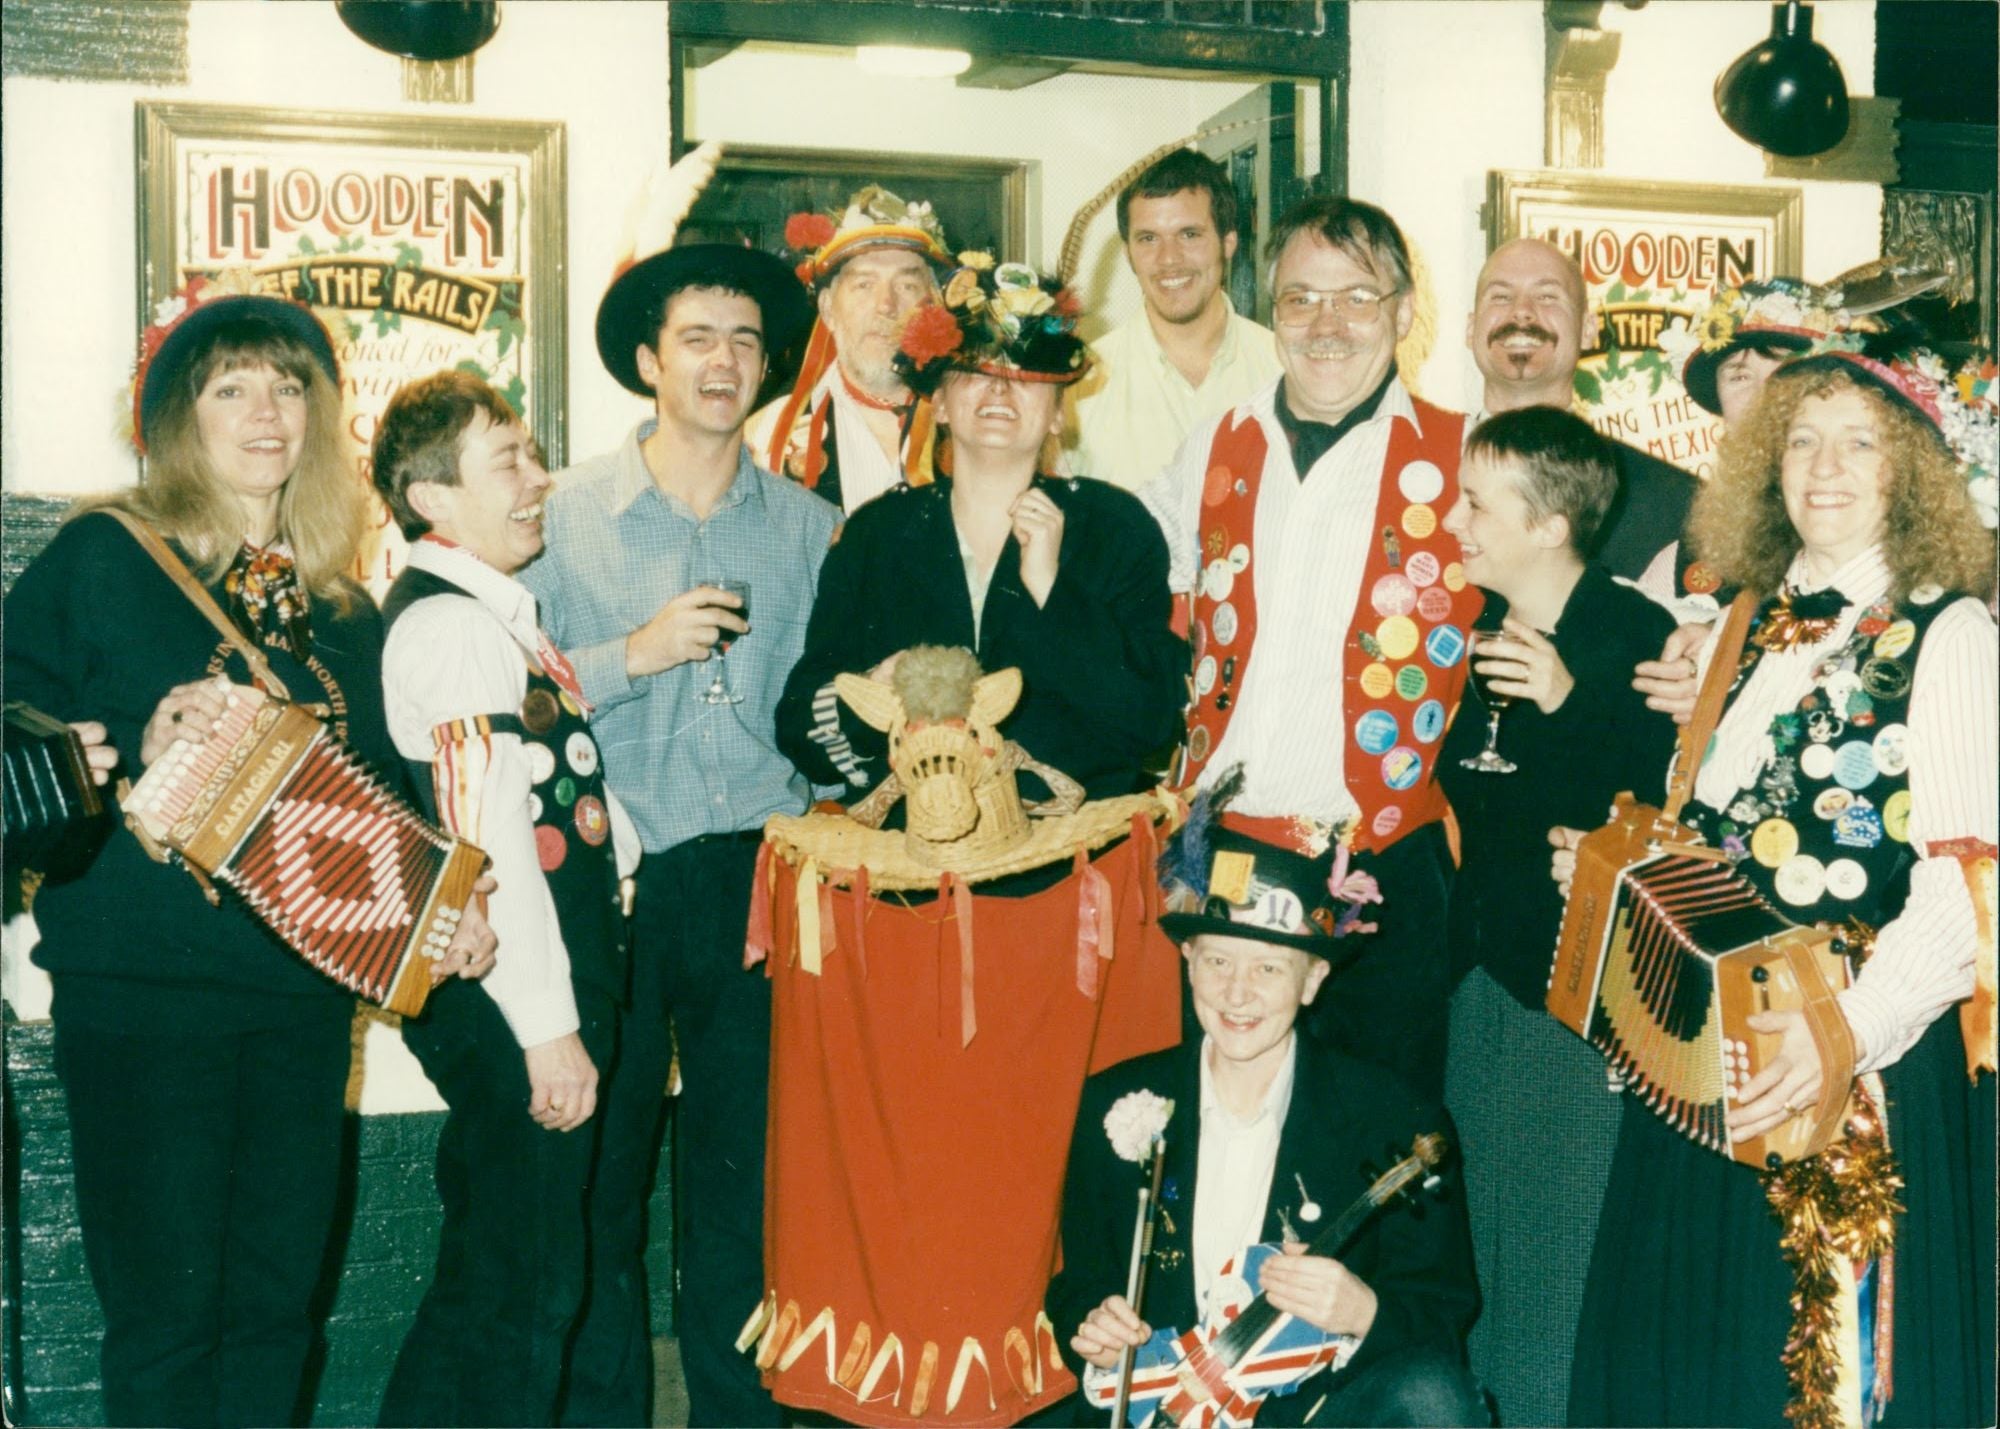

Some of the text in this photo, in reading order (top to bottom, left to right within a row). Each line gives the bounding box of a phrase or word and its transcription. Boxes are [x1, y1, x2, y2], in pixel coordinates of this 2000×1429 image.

[210, 166, 506, 266] HOODEN
[309, 265, 382, 307] THE
[392, 271, 484, 329] RAILS
[413, 339, 462, 369] for
[1612, 313, 1664, 347] THE
[1591, 394, 1698, 438] ING THE
[305, 654, 348, 715] WORTH
[215, 739, 294, 840] CASTAGNARI
